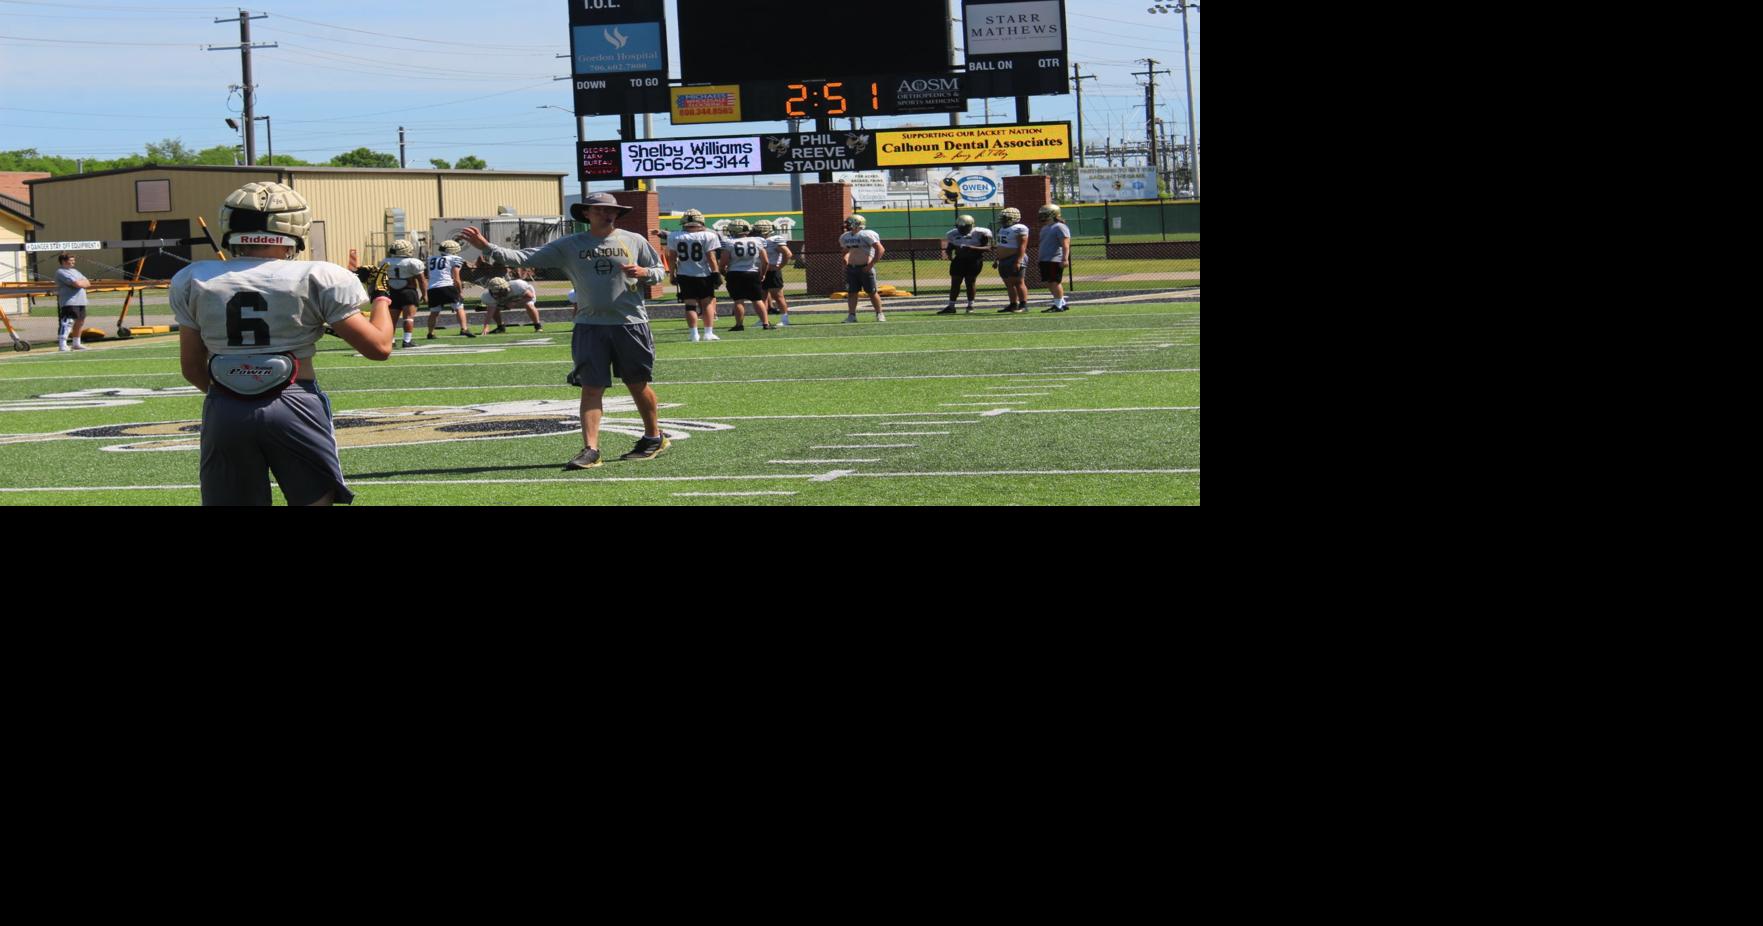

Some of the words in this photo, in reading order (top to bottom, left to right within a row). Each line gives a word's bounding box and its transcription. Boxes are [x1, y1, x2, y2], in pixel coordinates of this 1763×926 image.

[985, 13, 1040, 25] STARR
[971, 24, 1058, 37] MATHEWS
[617, 51, 658, 62] Hospital
[1038, 58, 1060, 68] QTR
[969, 61, 995, 71] BALL
[997, 60, 1013, 70] ON
[576, 80, 606, 90] DOWN
[630, 78, 642, 87] TO
[645, 77, 659, 87] GO
[897, 78, 960, 92] AOSM
[800, 134, 837, 145] PHIL
[882, 143, 940, 153] Calhoun
[944, 139, 989, 151] Dental
[992, 137, 1063, 149] Associates
[628, 143, 684, 158] Shelby
[690, 141, 753, 156] Williams
[792, 146, 846, 159] REEVE
[632, 154, 750, 172] 706-629-3144
[784, 159, 855, 172] STADIUM
[961, 183, 989, 191] OWEN
[240, 235, 284, 244] Riddell
[677, 241, 703, 262] 98
[734, 241, 757, 257] 68
[429, 257, 447, 271] 90
[226, 291, 270, 347] 6
